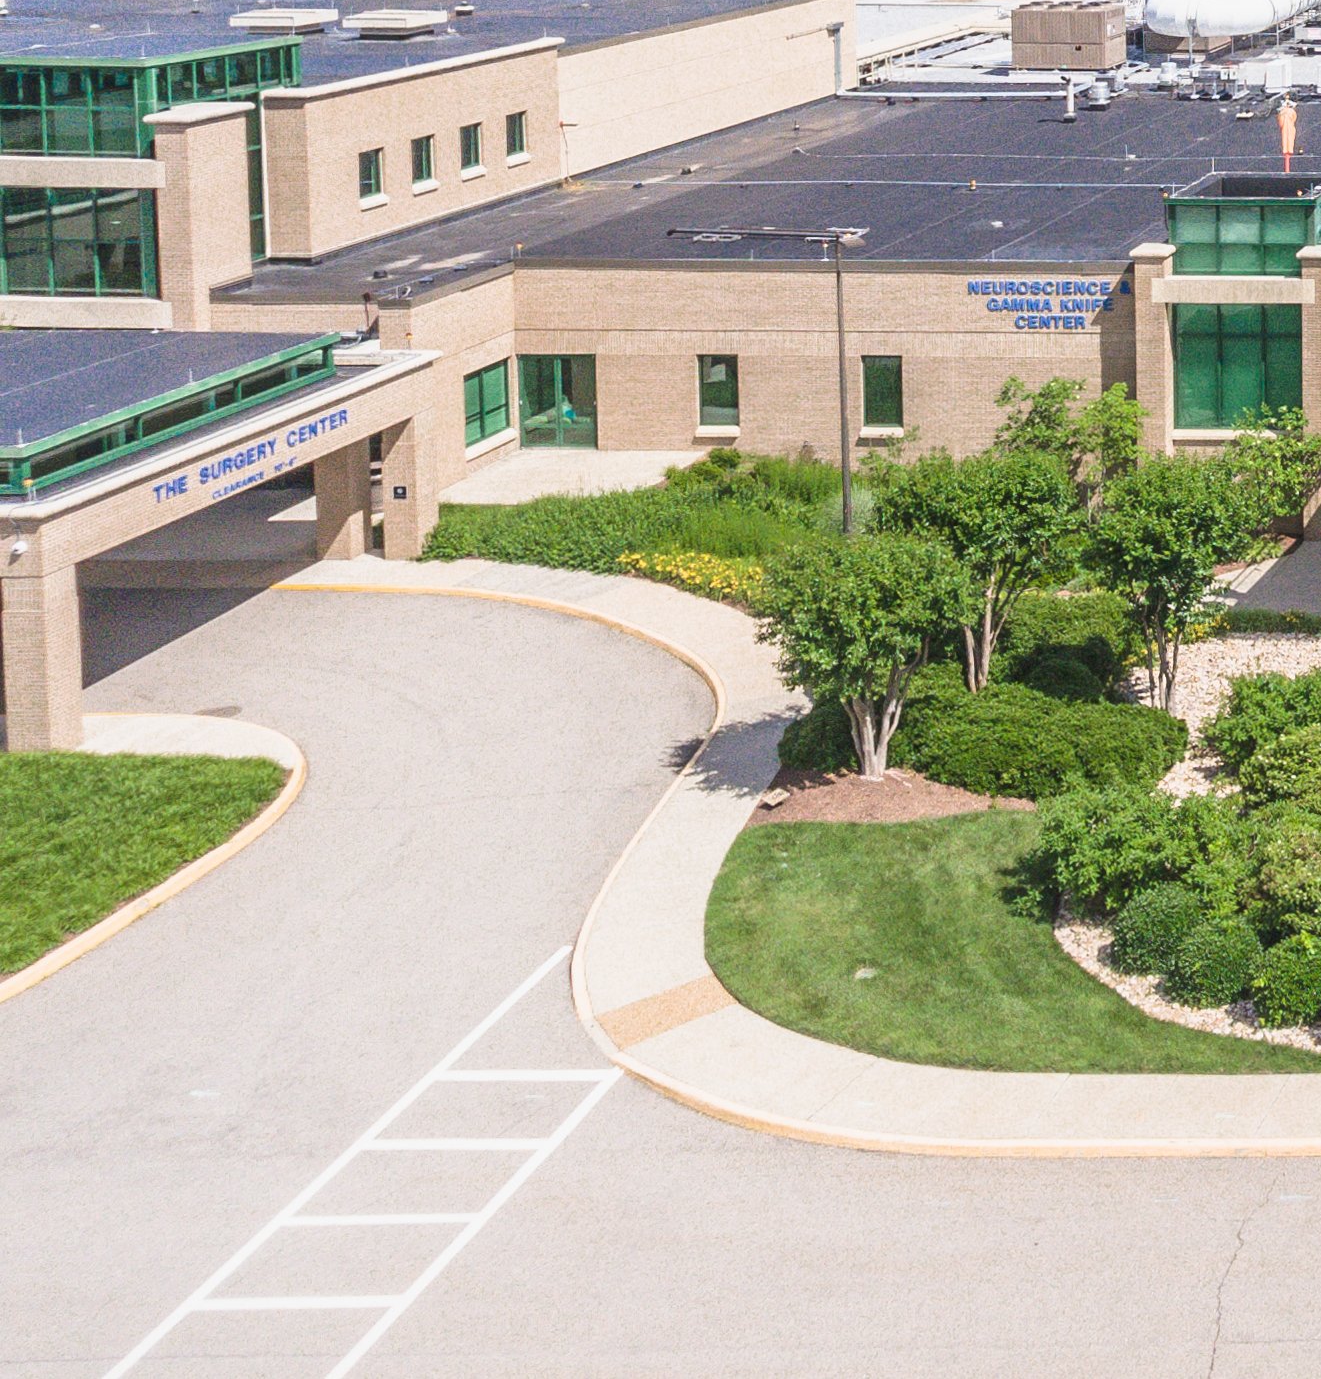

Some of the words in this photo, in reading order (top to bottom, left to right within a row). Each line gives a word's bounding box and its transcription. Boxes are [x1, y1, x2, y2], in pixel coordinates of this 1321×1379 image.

[967, 279, 1113, 296] NEUROSCIENCE
[1119, 280, 1131, 295] &
[986, 297, 1053, 313] GAMMA
[1060, 297, 1115, 313] KNIFE
[1014, 314, 1086, 330] CENTER
[153, 474, 188, 503] THE
[199, 437, 277, 484] SURGERY
[286, 409, 349, 448] CENTER
[212, 471, 265, 500] CLEARANCE
